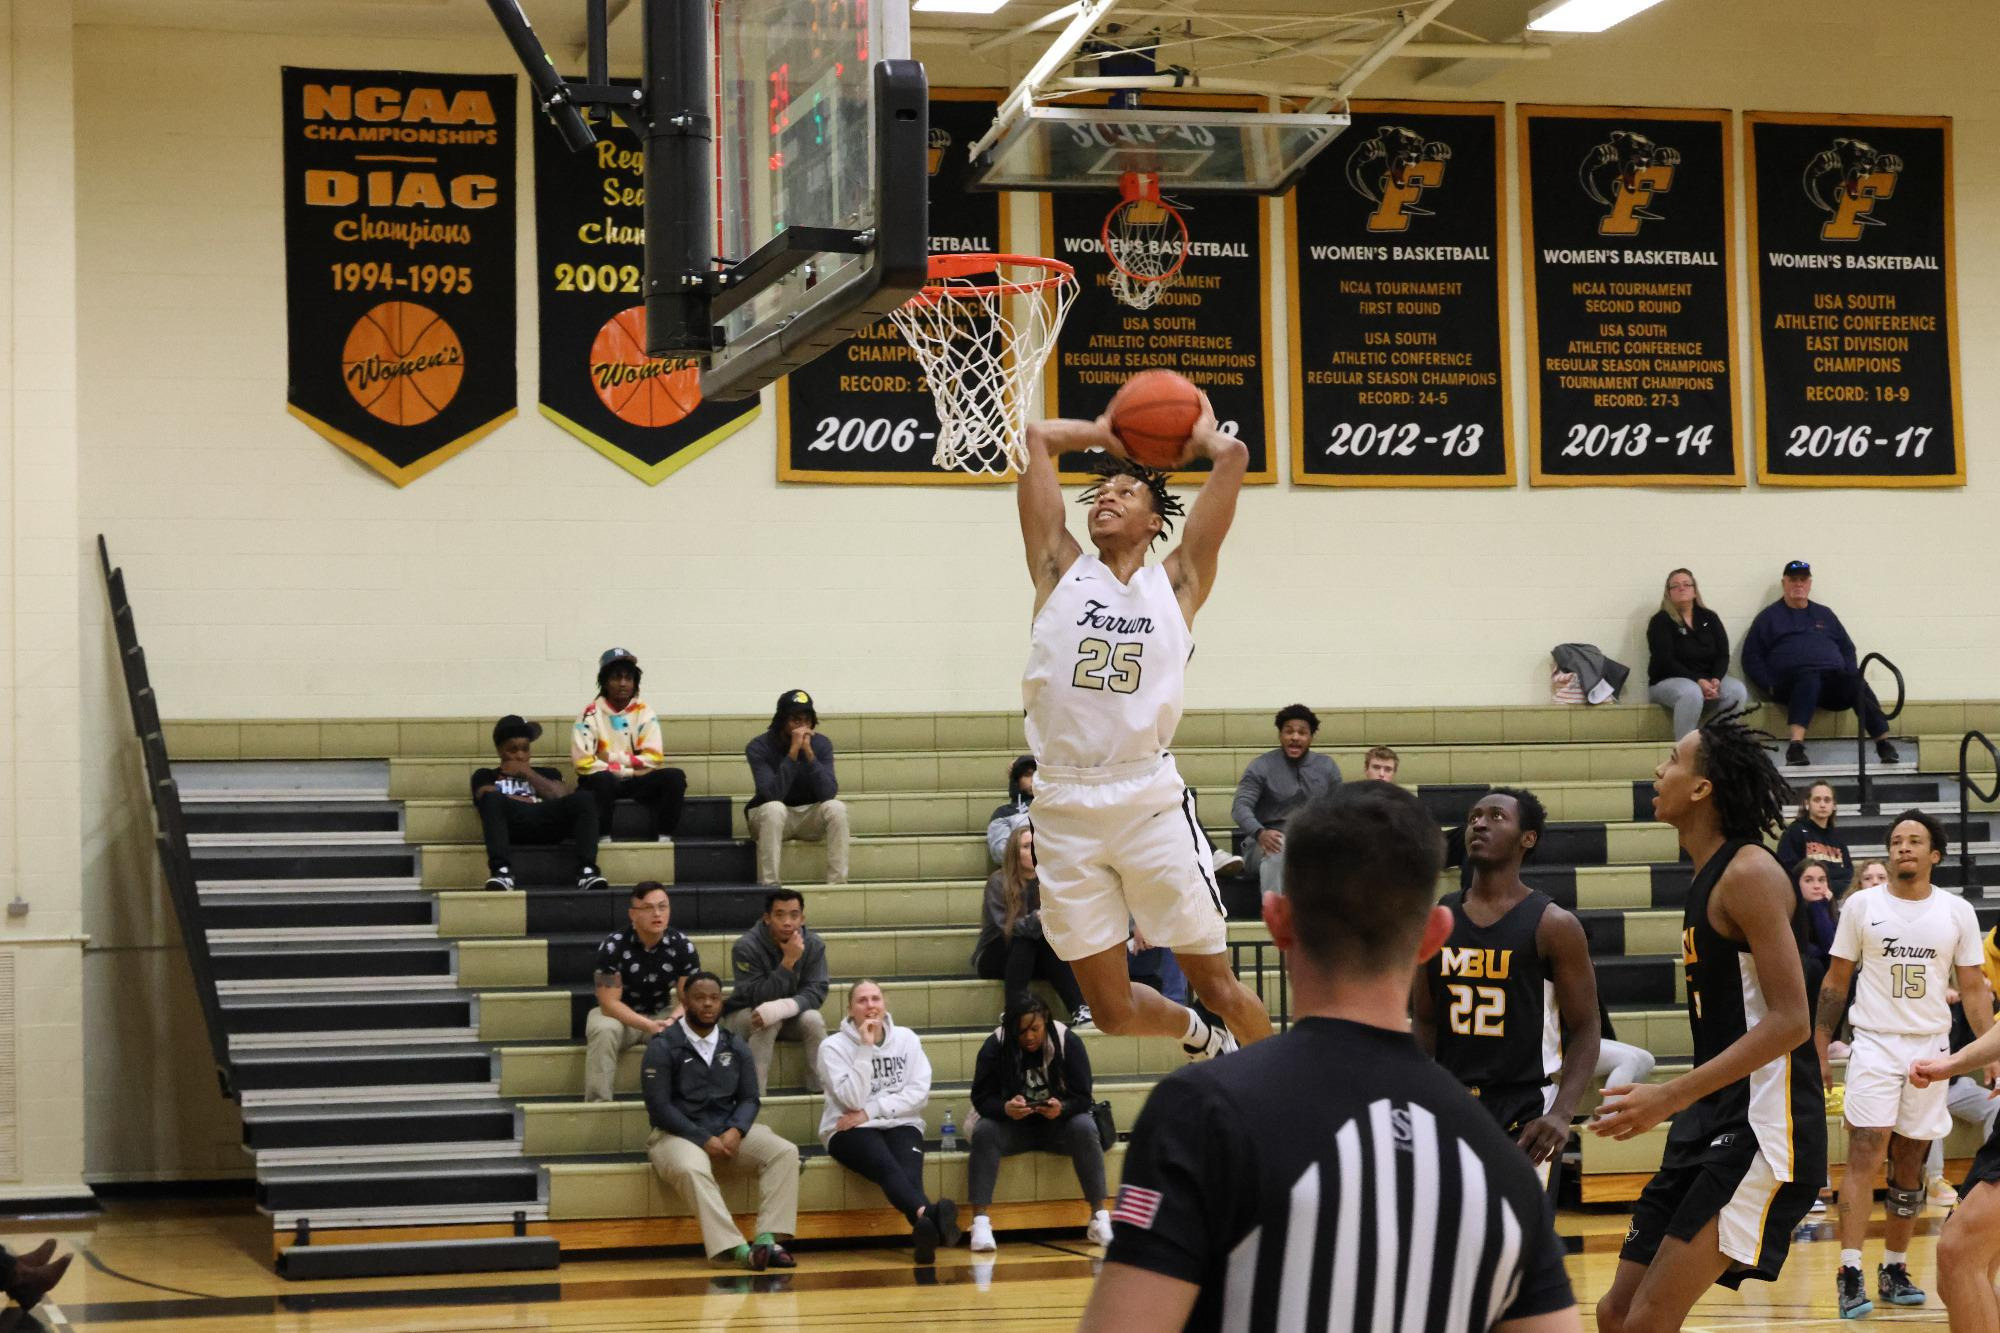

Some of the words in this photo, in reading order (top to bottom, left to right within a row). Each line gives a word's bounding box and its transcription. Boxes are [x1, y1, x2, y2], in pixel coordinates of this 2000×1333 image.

[303, 84, 496, 124] NCAA
[303, 125, 497, 145] CHAMPIONSHIPS
[304, 170, 497, 209] DIAC
[333, 213, 472, 250] Champions
[1064, 237, 1144, 254] WOMEN'S
[1149, 240, 1249, 257] BASKETBALL
[1310, 246, 1388, 261] WOMEN'S
[1392, 246, 1490, 261] BASKETBALL
[1543, 249, 1620, 265] WOMEN'S
[1624, 250, 1719, 266] BASKETBALL
[1769, 252, 1842, 269] WOMEN'S
[1846, 255, 1939, 270] BASKETBALL
[331, 263, 473, 294] 1994-1995
[1340, 281, 1371, 295] NCAA
[1375, 281, 1462, 296] TOURNAMENT
[1572, 282, 1606, 295] NCAA
[1609, 282, 1692, 296] TOURNAMENT
[1359, 302, 1392, 315] FIRST
[1397, 302, 1441, 315] ROUND
[1585, 300, 1634, 313] SECOND
[1638, 300, 1682, 314] ROUND
[1814, 294, 1843, 309] USA
[1847, 294, 1896, 310] SOUTH
[1123, 317, 1149, 330] USA
[1153, 317, 1196, 330] SOUTH
[1600, 324, 1624, 337] USA
[1628, 324, 1667, 337] SOUTH
[1774, 315, 1839, 330] ATHLETIC
[1843, 316, 1936, 331] CONFERENCE
[1089, 335, 1144, 348] ATHLETIC
[1149, 335, 1232, 350] CONFERENCE
[1365, 332, 1391, 345] USA
[1395, 332, 1437, 345] SOUTH
[1806, 336, 1840, 351] EAST
[1844, 336, 1908, 351] DIVISION
[1568, 341, 1620, 354] ATHLETIC
[1624, 342, 1702, 355] CONFERENCE
[1064, 353, 1121, 366] REGULAR
[1125, 353, 1177, 366] SEASON
[1181, 354, 1256, 368] CHAMPIONS
[1332, 351, 1387, 365] ATHLETIC
[1391, 352, 1473, 366] CONFERENCE
[1546, 358, 1598, 371] REGULAR
[1601, 359, 1650, 372] SEASON
[1654, 359, 1725, 373] CHAMPIONS
[1814, 357, 1901, 373] CHAMPIONS
[348, 345, 460, 390] Women's
[840, 375, 911, 392] RECORD:
[1307, 371, 1363, 385] REGULAR
[1367, 372, 1418, 385] SEASON
[1421, 372, 1497, 386] CHAMPIONS
[1560, 376, 1638, 389] TOURNAMENT
[1641, 376, 1714, 390] CHAMPIONS
[1359, 392, 1415, 405] RECORD:
[1418, 392, 1448, 405] 24-5
[1594, 394, 1647, 407] RECORD:
[1651, 394, 1679, 407] 27-3
[1806, 386, 1869, 401] RECORD:
[1875, 386, 1910, 402] 18-9
[1325, 422, 1485, 457] 2012-13
[1561, 423, 1714, 457] 2013-14
[1785, 425, 1933, 458] 2016-17
[1077, 599, 1154, 634] Ferrum
[1072, 637, 1143, 694] 25
[1882, 937, 1937, 959] Ferrum
[1440, 947, 1513, 979] MBU
[1890, 963, 1926, 999] 15
[1447, 984, 1506, 1037] 22
